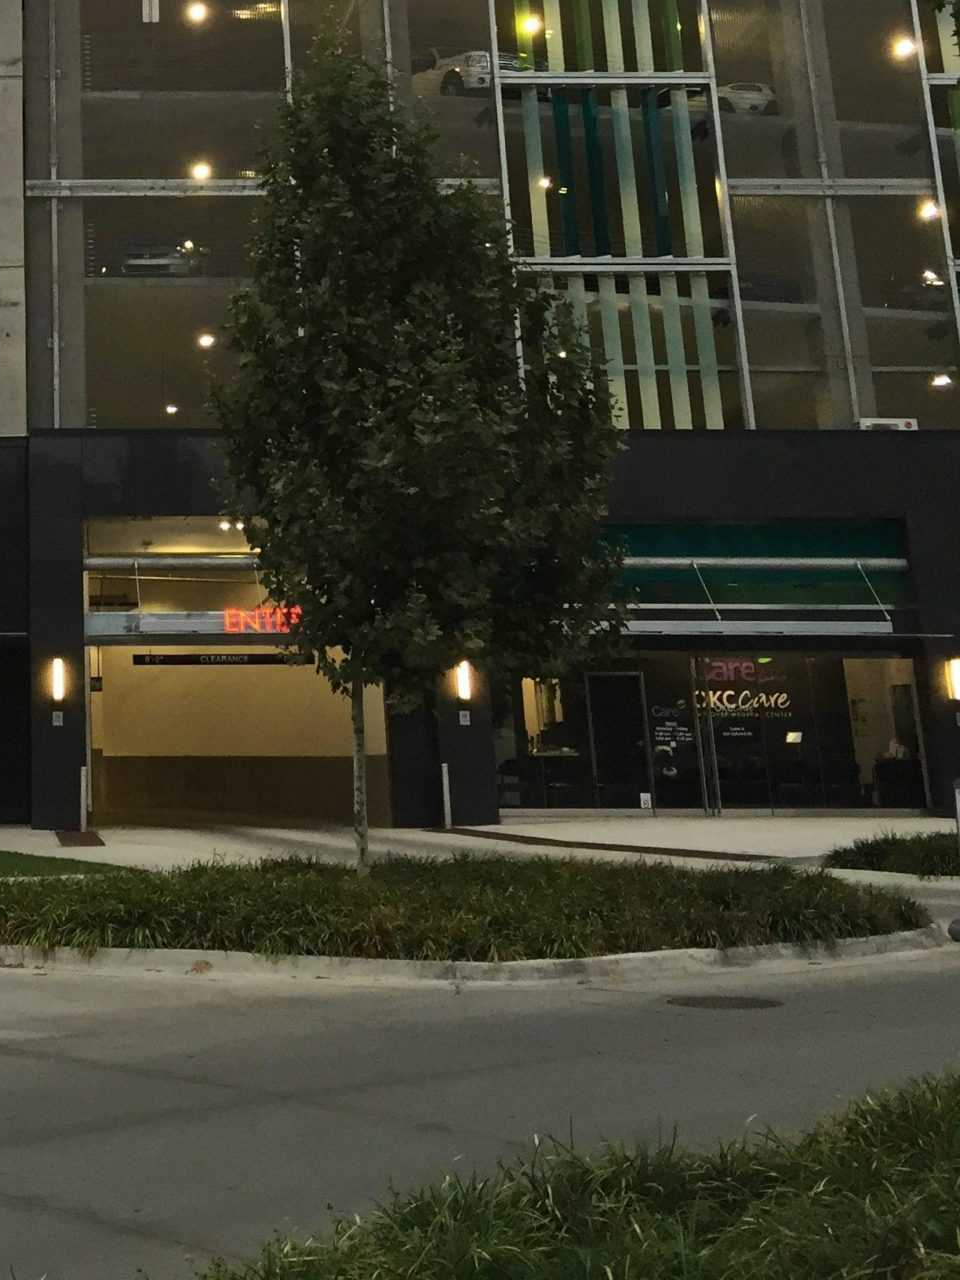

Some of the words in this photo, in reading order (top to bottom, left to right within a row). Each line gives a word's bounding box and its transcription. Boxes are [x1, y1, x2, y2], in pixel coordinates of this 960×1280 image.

[200, 655, 248, 664] CLEARANCE
[704, 660, 755, 681] are
[738, 690, 791, 709] Care
